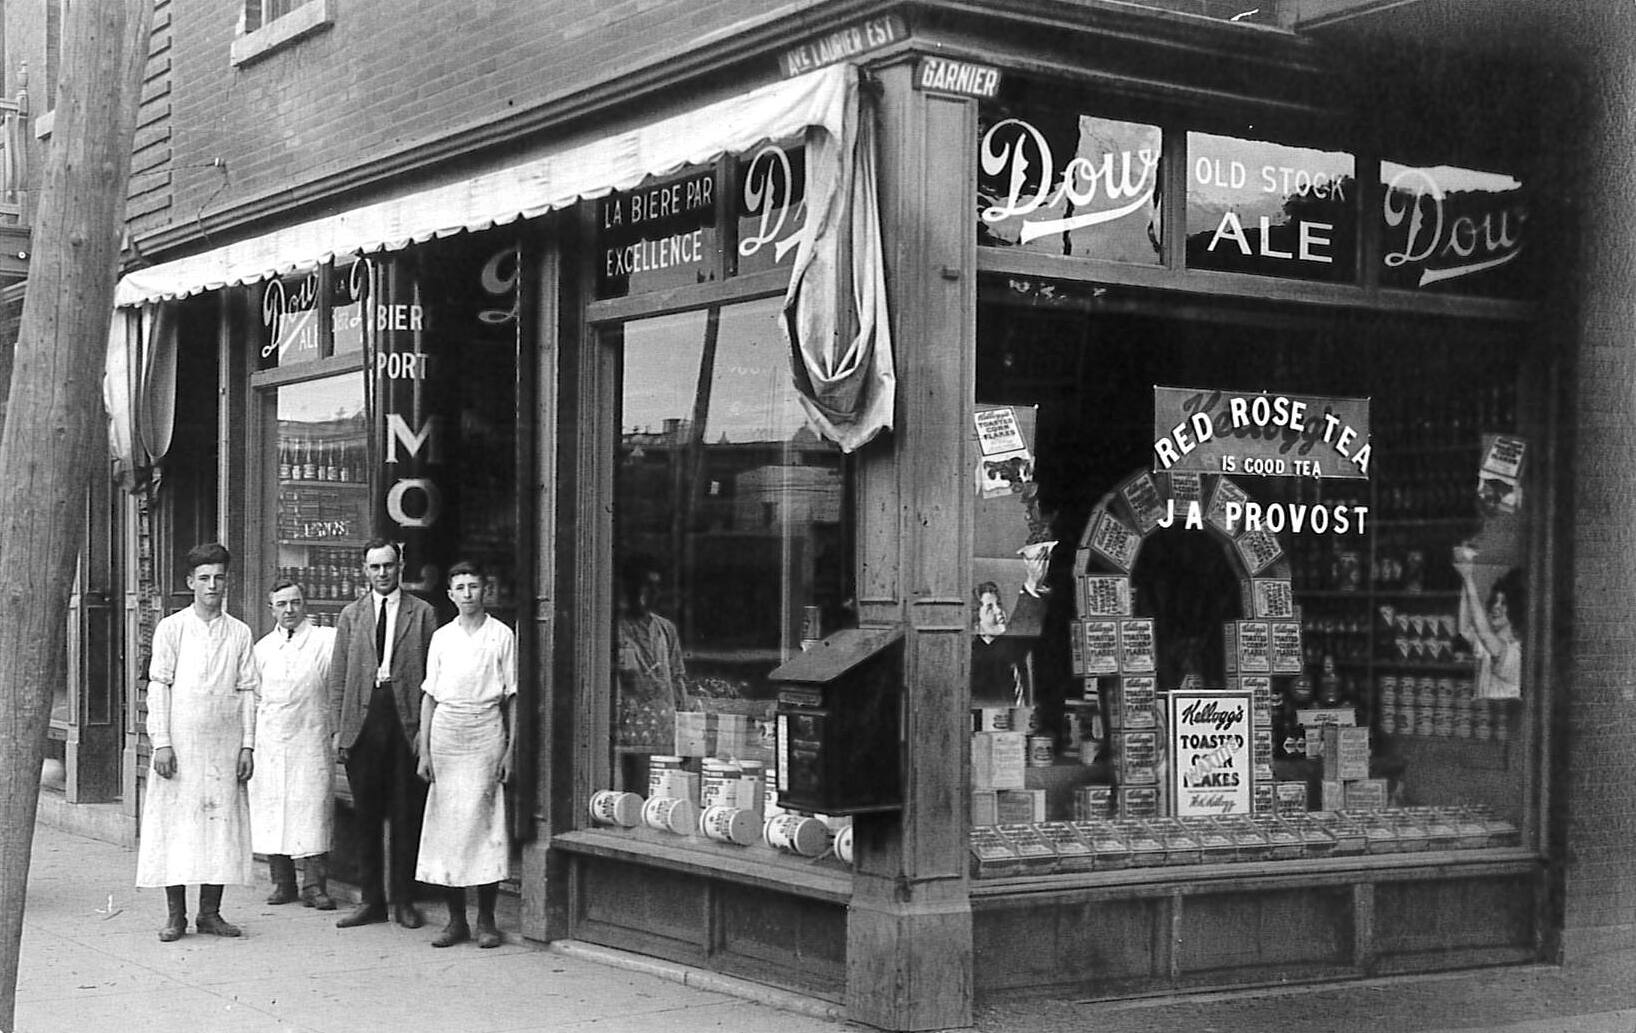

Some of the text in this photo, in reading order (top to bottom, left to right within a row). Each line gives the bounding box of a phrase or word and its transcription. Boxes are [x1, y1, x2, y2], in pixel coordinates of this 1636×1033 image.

[866, 15, 894, 47] EST
[921, 60, 998, 96] GARNIER
[981, 118, 1162, 245] Dow
[1195, 156, 1346, 202] OLD STOCK
[604, 176, 713, 229] LA BIERE PAR
[606, 231, 702, 277] EXCELLENCE
[1206, 211, 1334, 263] ALE
[376, 352, 430, 380] PORT
[1154, 396, 1372, 473] RED ROSE TEA
[1222, 455, 1322, 476] IS GOOD TEA
[1157, 498, 1175, 529] J
[1185, 500, 1204, 530] A
[1225, 501, 1369, 534] PROVOST
[1182, 700, 1243, 730] Kellogg's
